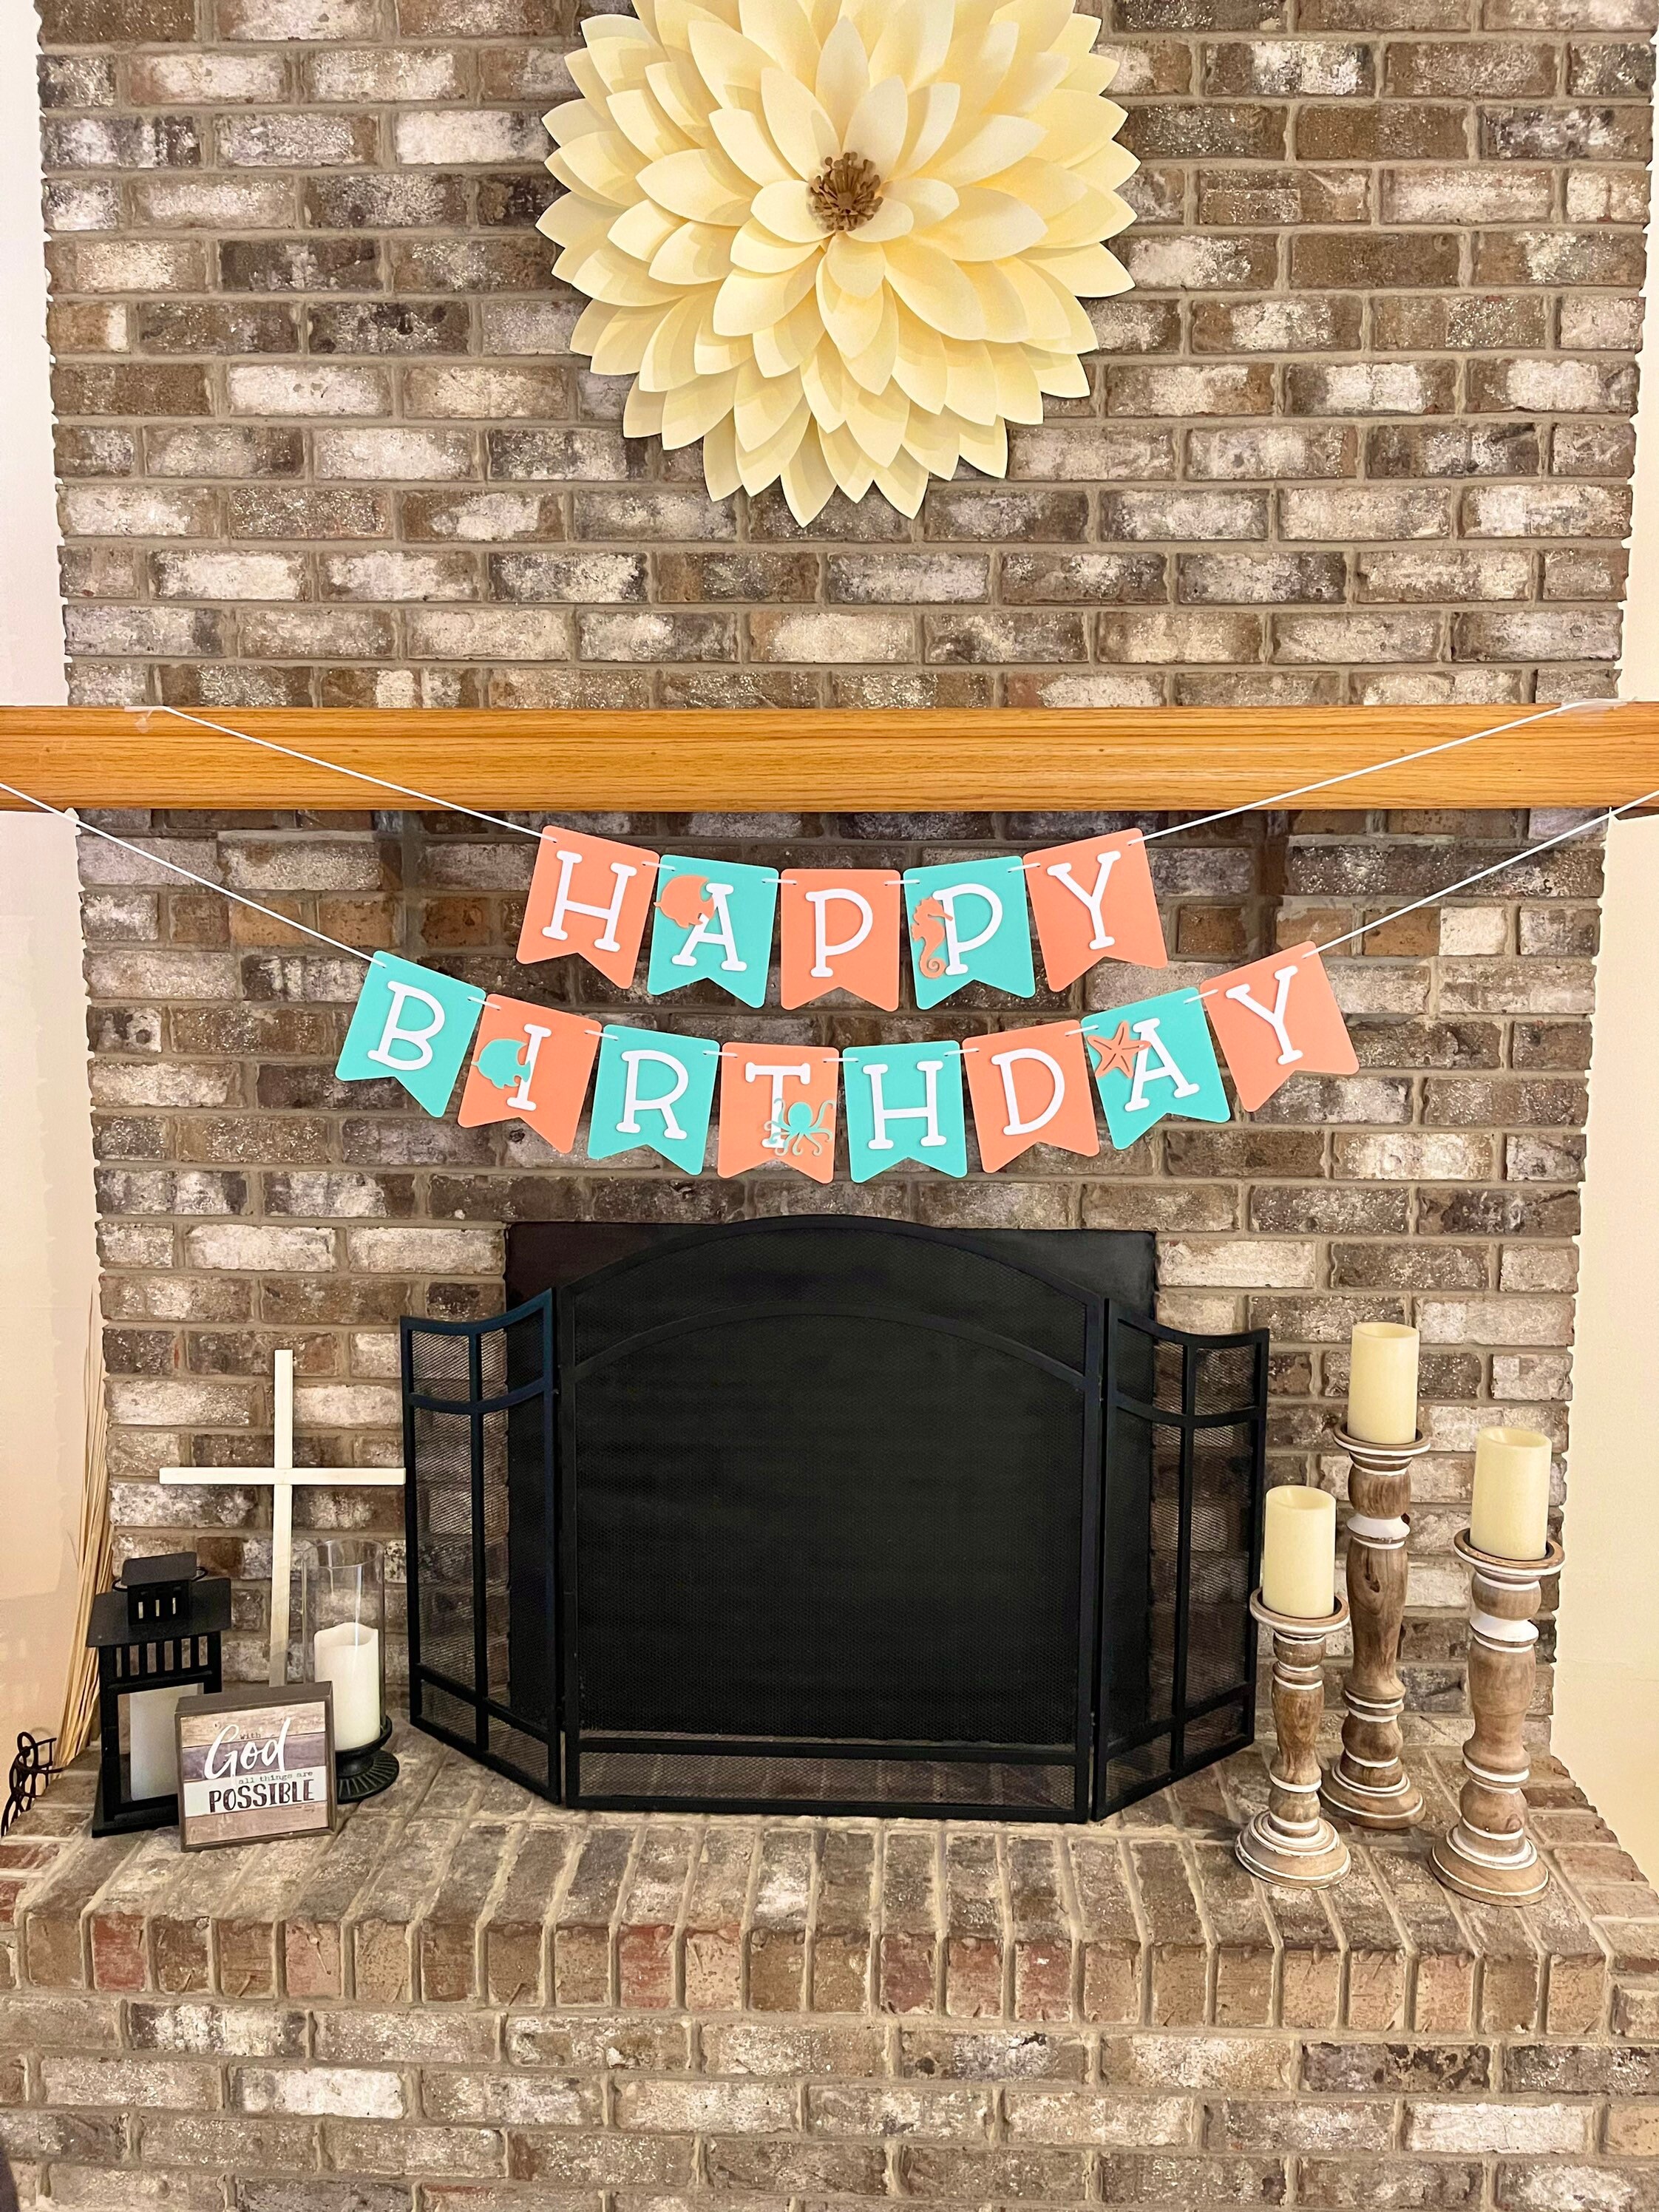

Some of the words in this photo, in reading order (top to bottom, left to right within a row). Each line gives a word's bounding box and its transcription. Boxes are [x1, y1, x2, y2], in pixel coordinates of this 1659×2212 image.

[542, 850, 1121, 977] HAPPY
[367, 966, 1303, 1150] BIRTHDAY
[204, 1717, 291, 1782] God
[240, 1732, 261, 1740] with
[208, 1779, 315, 1814] POSSIBLE
[238, 1777, 255, 1785] all
[259, 1773, 292, 1783] things
[296, 1770, 313, 1778] are
